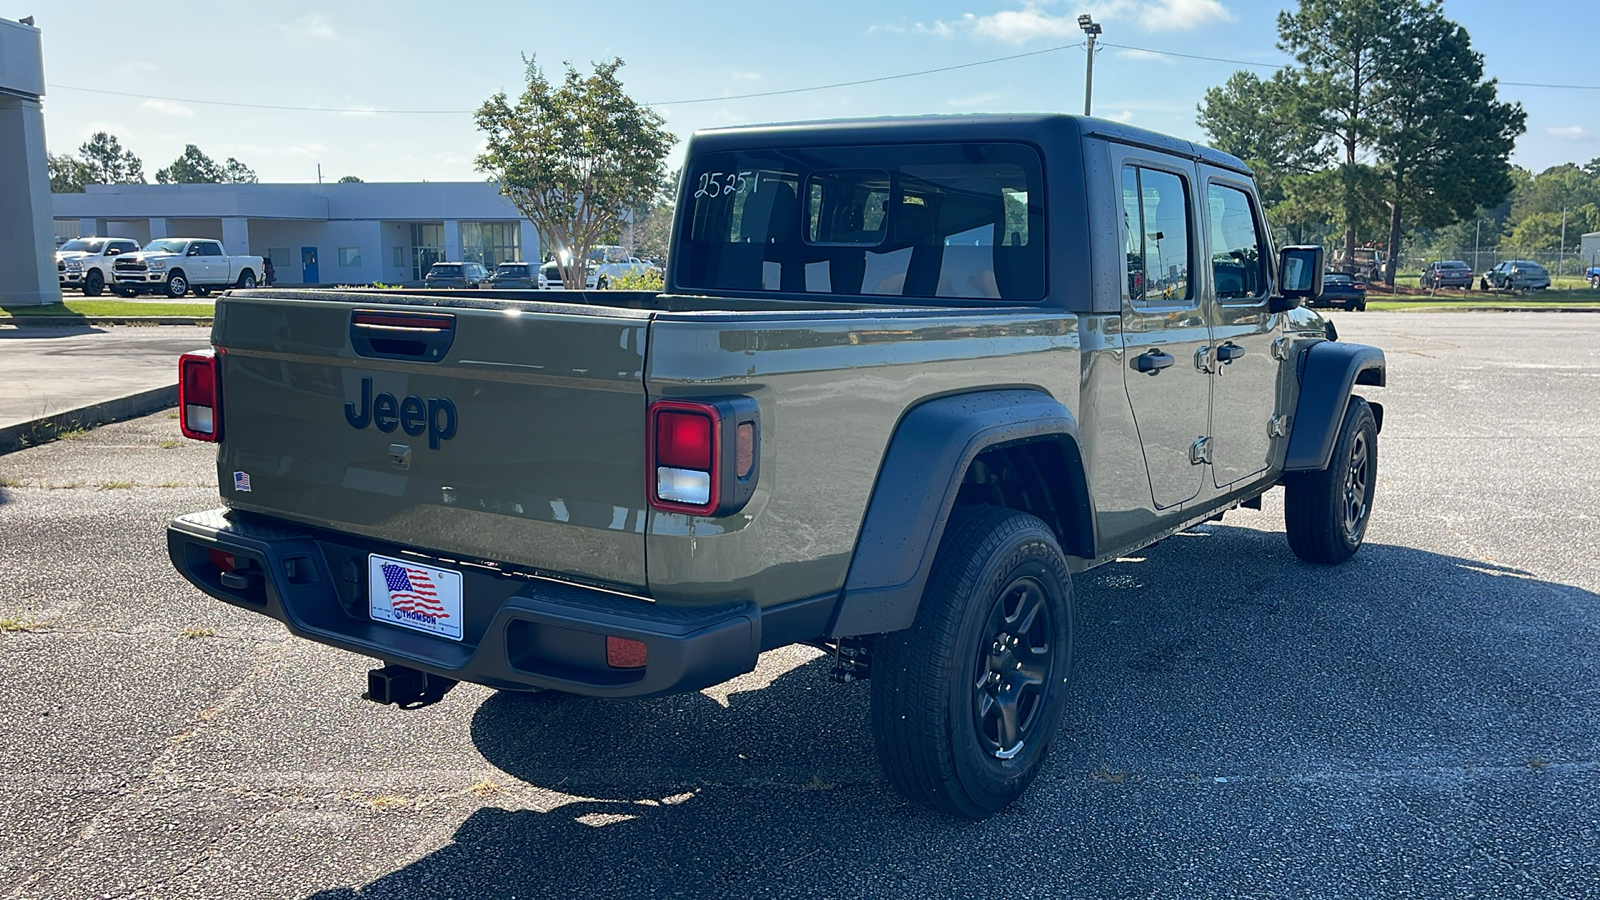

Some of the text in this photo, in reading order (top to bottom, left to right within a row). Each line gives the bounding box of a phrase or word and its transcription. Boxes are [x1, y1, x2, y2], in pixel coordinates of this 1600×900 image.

[694, 171, 759, 198] 25251
[344, 377, 458, 450] Jeep
[403, 610, 437, 625] THOMSON
